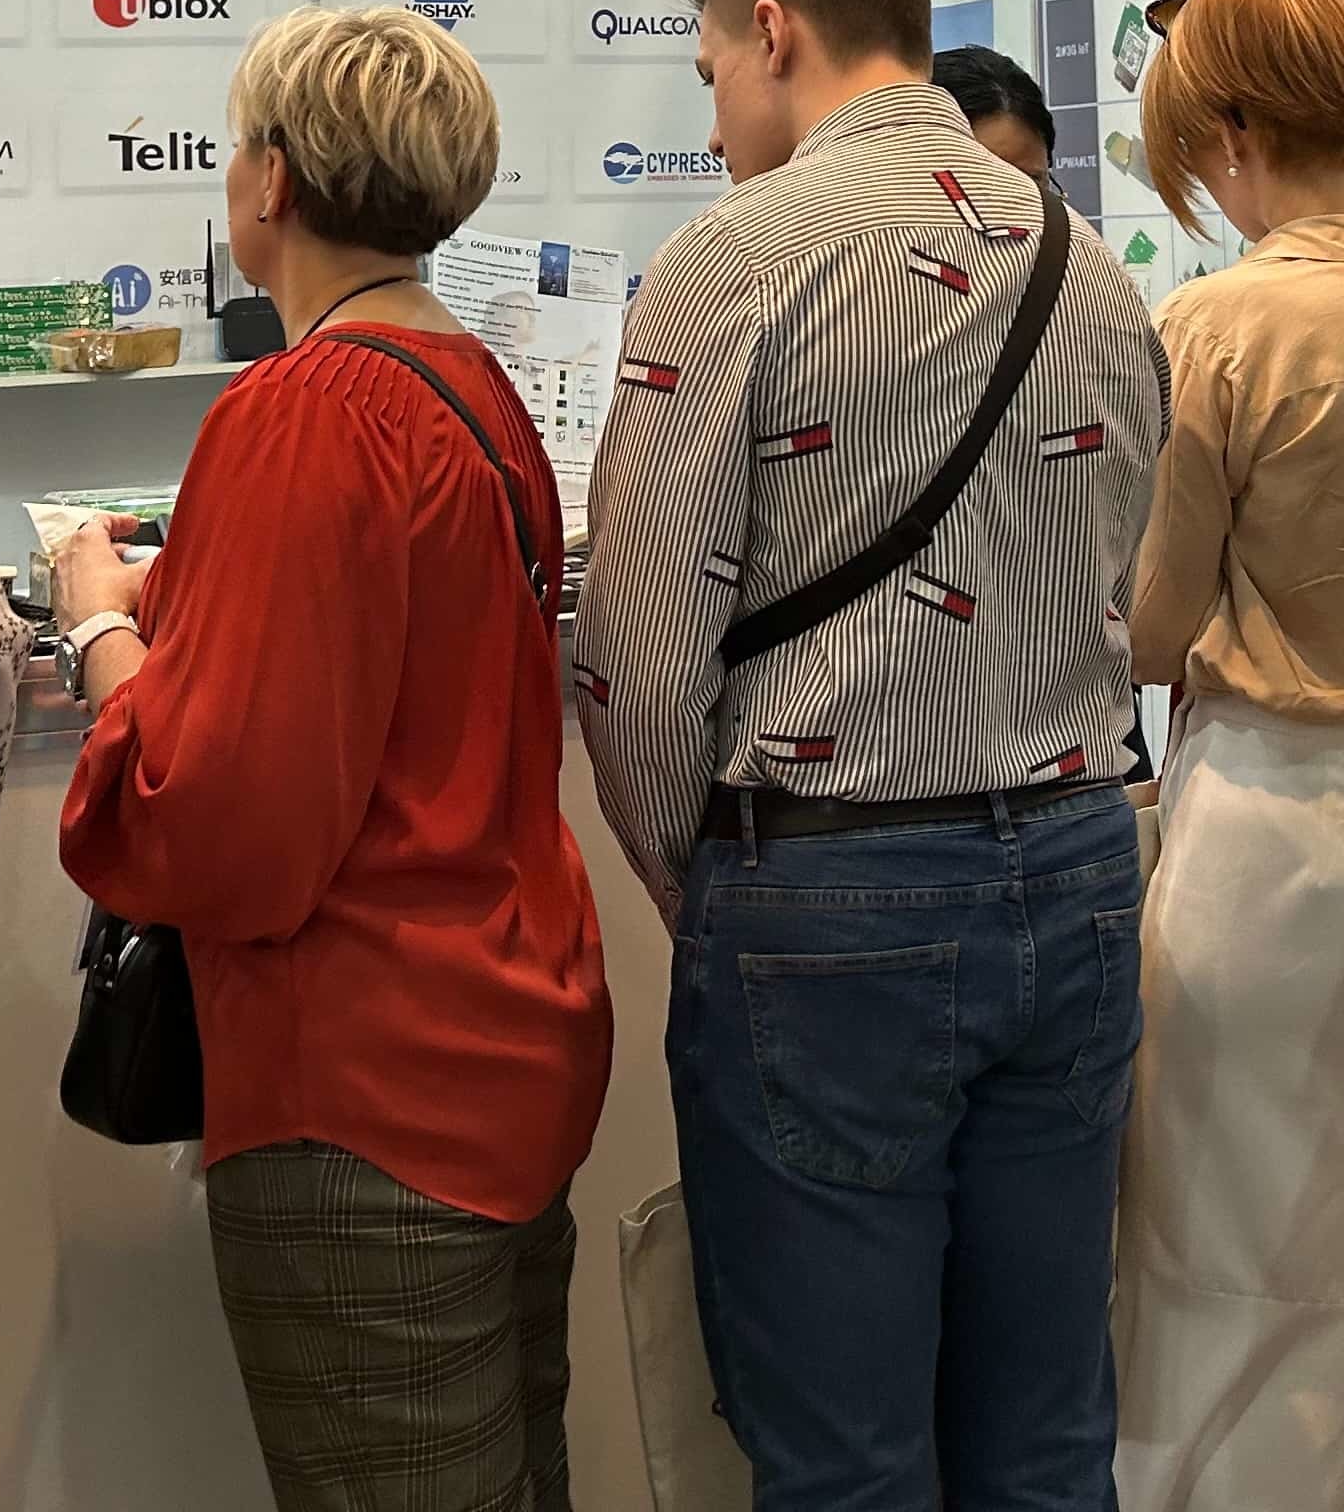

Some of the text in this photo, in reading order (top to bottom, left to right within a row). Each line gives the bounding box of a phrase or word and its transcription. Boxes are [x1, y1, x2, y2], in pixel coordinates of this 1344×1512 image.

[108, 128, 217, 172] Telit
[647, 152, 723, 173] CYPRESS
[470, 241, 522, 256] GOODVIEW
